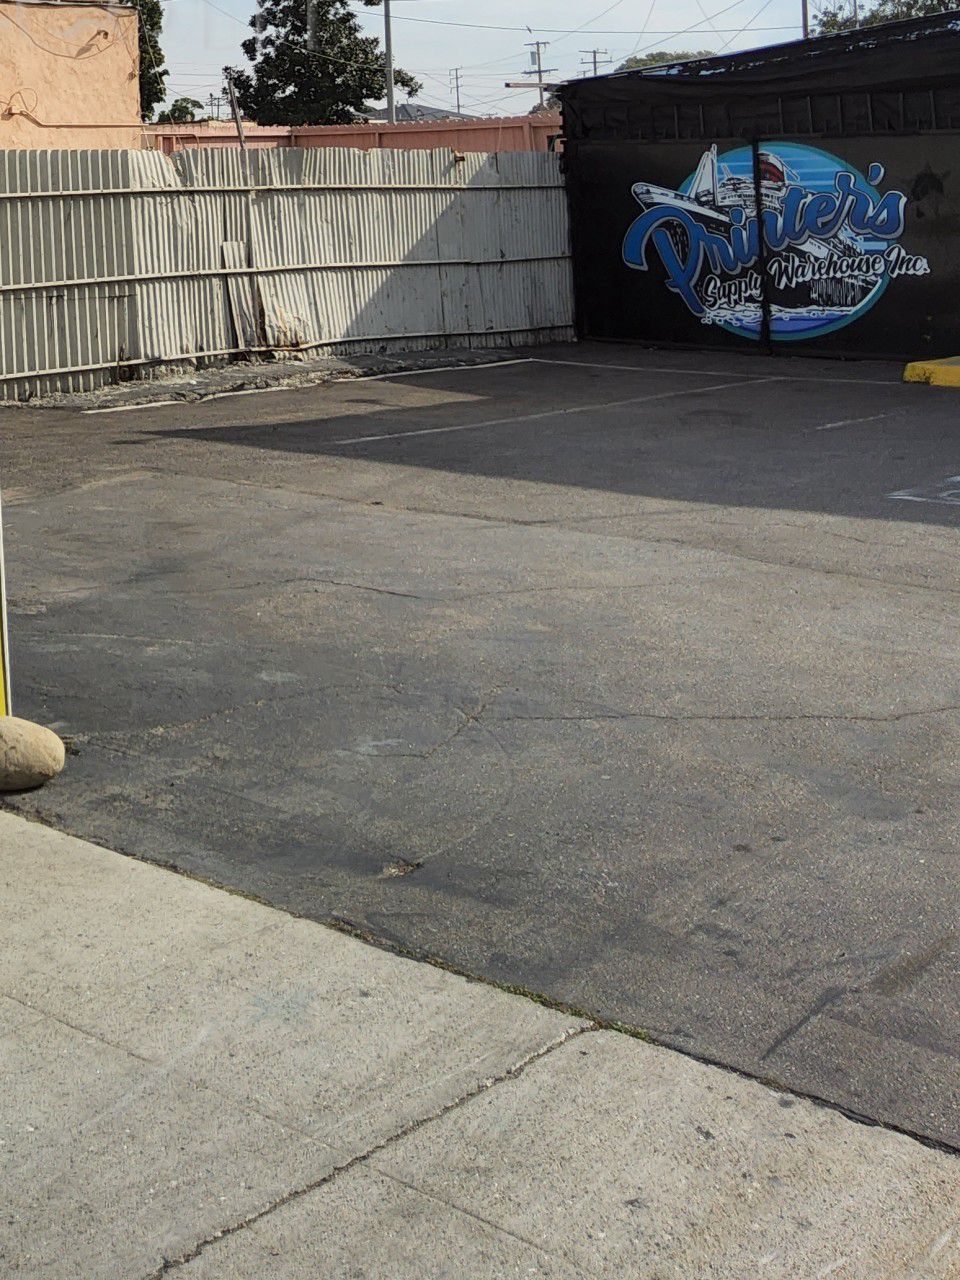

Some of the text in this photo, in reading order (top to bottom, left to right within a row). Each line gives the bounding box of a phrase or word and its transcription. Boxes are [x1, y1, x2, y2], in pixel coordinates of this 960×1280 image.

[622, 162, 907, 317] Printer's
[703, 243, 931, 308] Supply Warehouse Inc.
